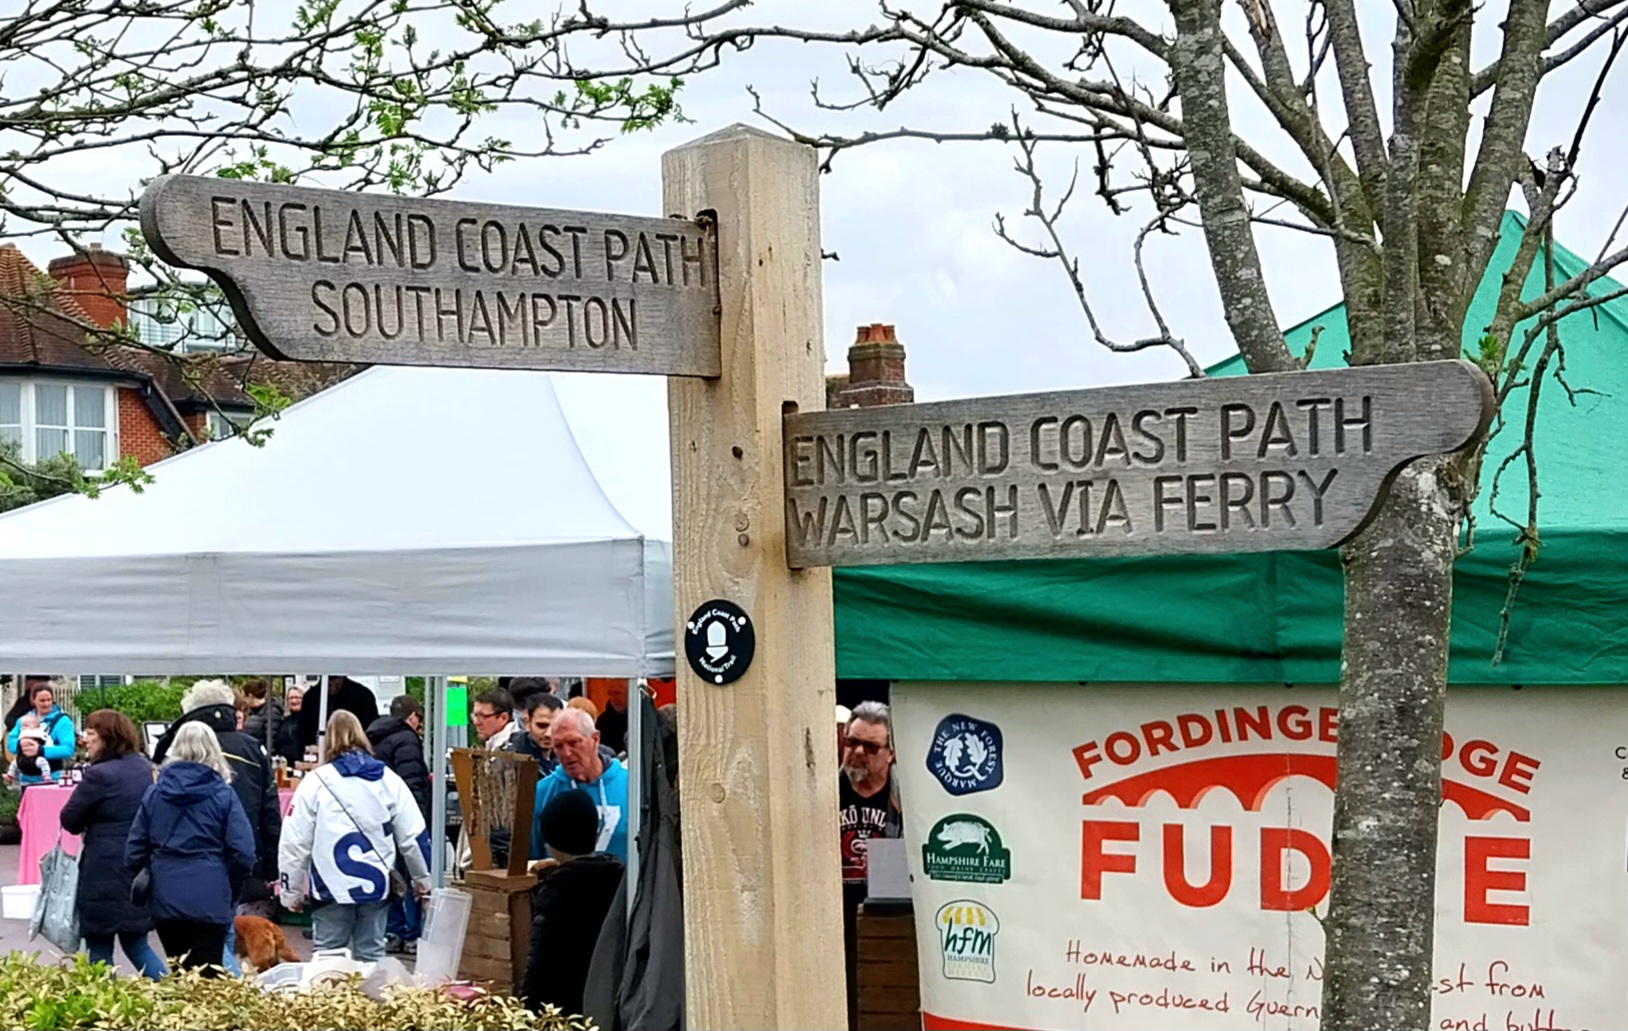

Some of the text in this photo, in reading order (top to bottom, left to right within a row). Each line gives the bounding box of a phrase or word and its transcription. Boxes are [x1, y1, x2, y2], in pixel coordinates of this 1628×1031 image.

[210, 196, 706, 287] ENGLAND COAST PATH
[311, 279, 639, 351] SOUTHAMPTON
[790, 396, 1372, 487] ENGLAND COAST PATH
[788, 468, 1339, 548] WARSASH VIA FERRY
[934, 721, 997, 775] THE NEW FOREST
[934, 761, 977, 789] MARQUE
[926, 852, 1006, 868] HAMPSHIRE FARE
[1080, 820, 1530, 926] FUDE
[1027, 969, 1096, 1013] locally
[1109, 988, 1229, 1014] produced
[1211, 956, 1231, 974] in
[1247, 947, 1291, 979] the
